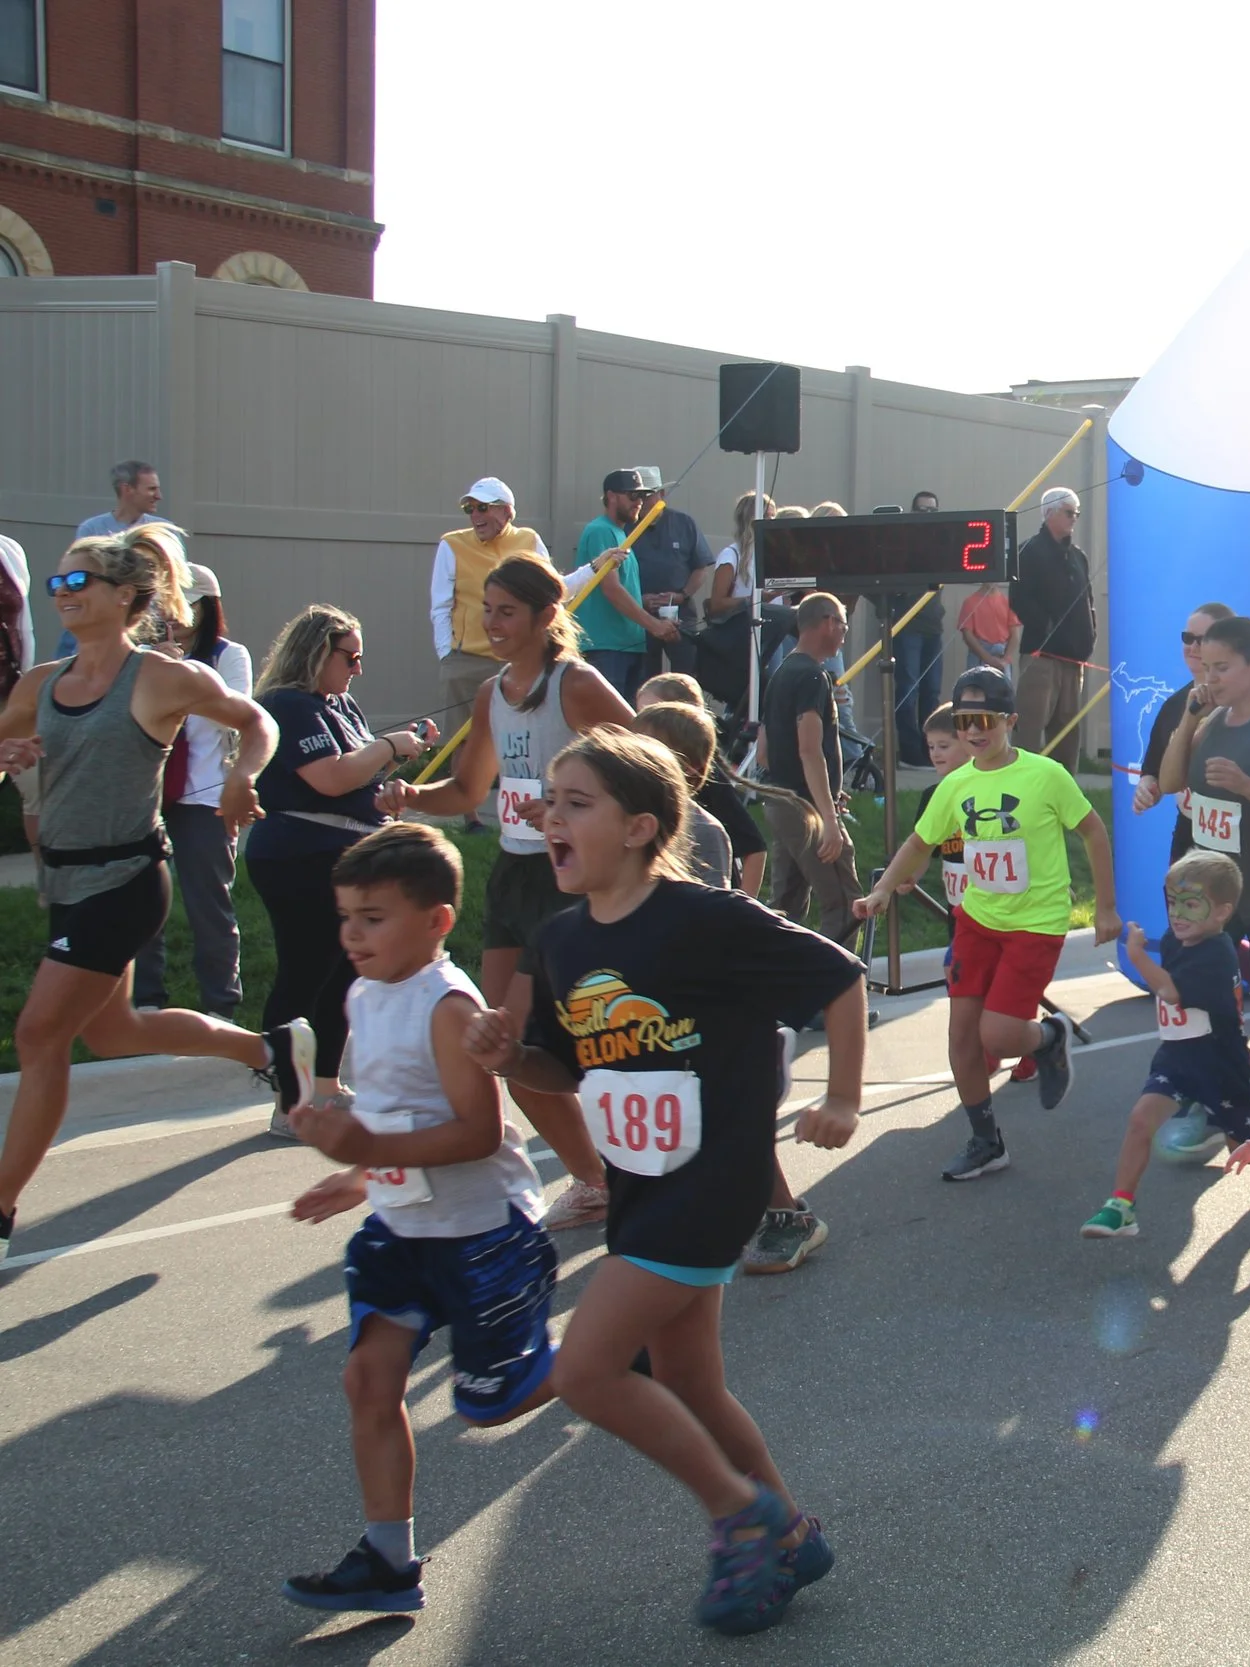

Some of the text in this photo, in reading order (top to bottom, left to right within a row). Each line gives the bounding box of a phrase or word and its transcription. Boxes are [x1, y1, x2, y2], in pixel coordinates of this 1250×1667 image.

[963, 521, 991, 571] 2
[299, 734, 332, 754] STAFF
[501, 790, 531, 825] 29
[1198, 805, 1233, 840] 445
[973, 851, 1018, 881] 471
[576, 1027, 640, 1068] ELON
[598, 1092, 681, 1152] 189
